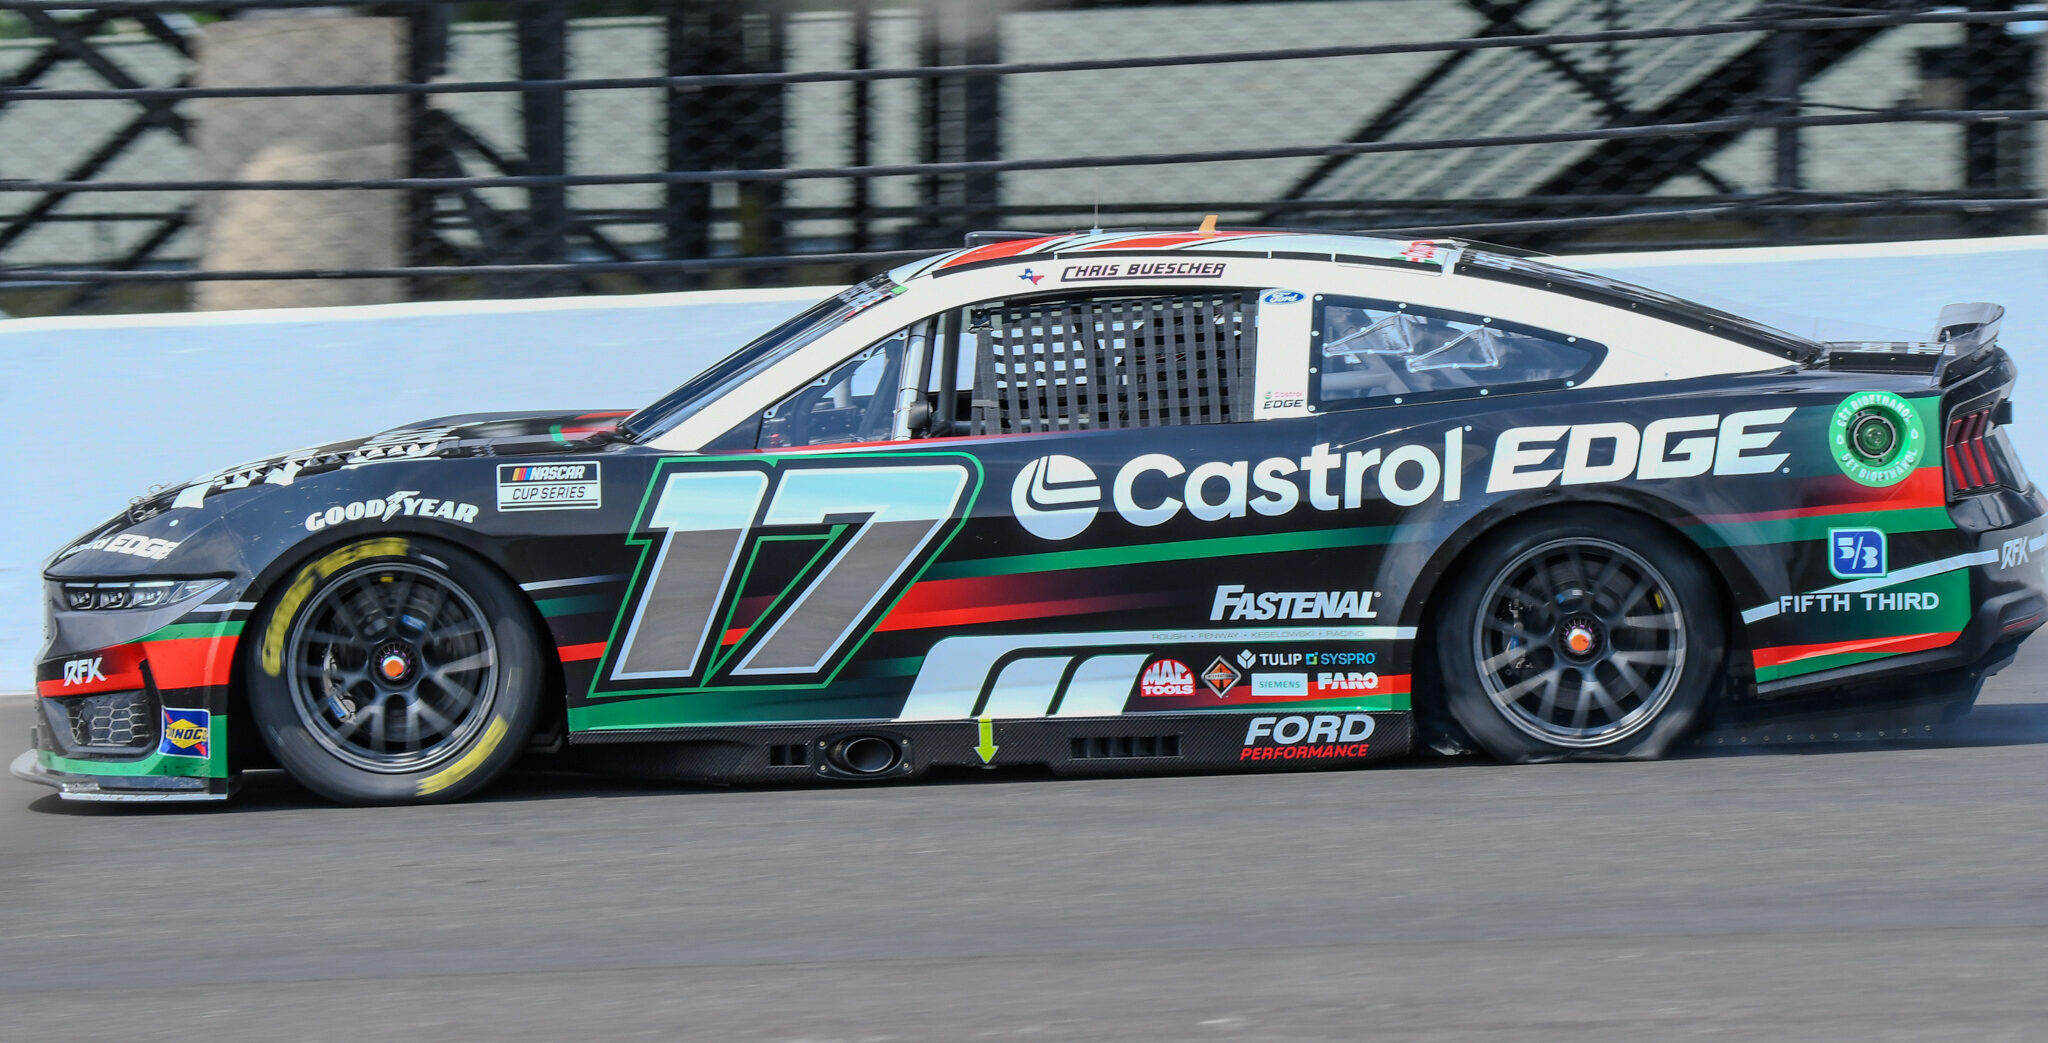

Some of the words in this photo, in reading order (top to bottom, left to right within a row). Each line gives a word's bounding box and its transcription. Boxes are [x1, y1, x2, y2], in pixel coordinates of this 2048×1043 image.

[1061, 264, 1120, 282] CHRIS
[1127, 262, 1227, 279] BUESCHER
[1263, 399, 1304, 409] EDGE
[1837, 407, 1852, 427] GET
[1850, 394, 1913, 425] BIOETHANOL
[529, 465, 586, 481] NASCAR
[1113, 426, 1464, 527] Castrol
[1486, 406, 1798, 494] EDGE
[1842, 452, 1859, 472] GET
[1858, 449, 1918, 481] BIOETHANOL
[512, 487, 539, 500] CUP
[541, 486, 586, 499] SERIES
[305, 491, 479, 531] GOODYEAR
[103, 533, 182, 560] EDGE
[2000, 536, 2030, 570] RFK
[609, 464, 969, 681] 17
[1210, 585, 1378, 621] FASTENAL
[1780, 593, 1850, 613] FIFTH
[1860, 592, 1940, 611] THIRD
[1152, 632, 1187, 640] ROUSH
[1199, 631, 1239, 640] FENWAY
[1251, 630, 1314, 639] KESELOWSKI
[1326, 629, 1365, 638] RACING
[1259, 653, 1303, 666] TULIP
[1320, 652, 1376, 666] SYSPRO
[64, 656, 107, 687] RFK
[1142, 660, 1194, 686] MAC
[1317, 671, 1379, 691] FARO
[1143, 685, 1194, 696] TOOLS
[1258, 680, 1301, 689] SIEMENS
[1244, 713, 1376, 746] FORD
[1240, 744, 1370, 761] PERFORMANCE
